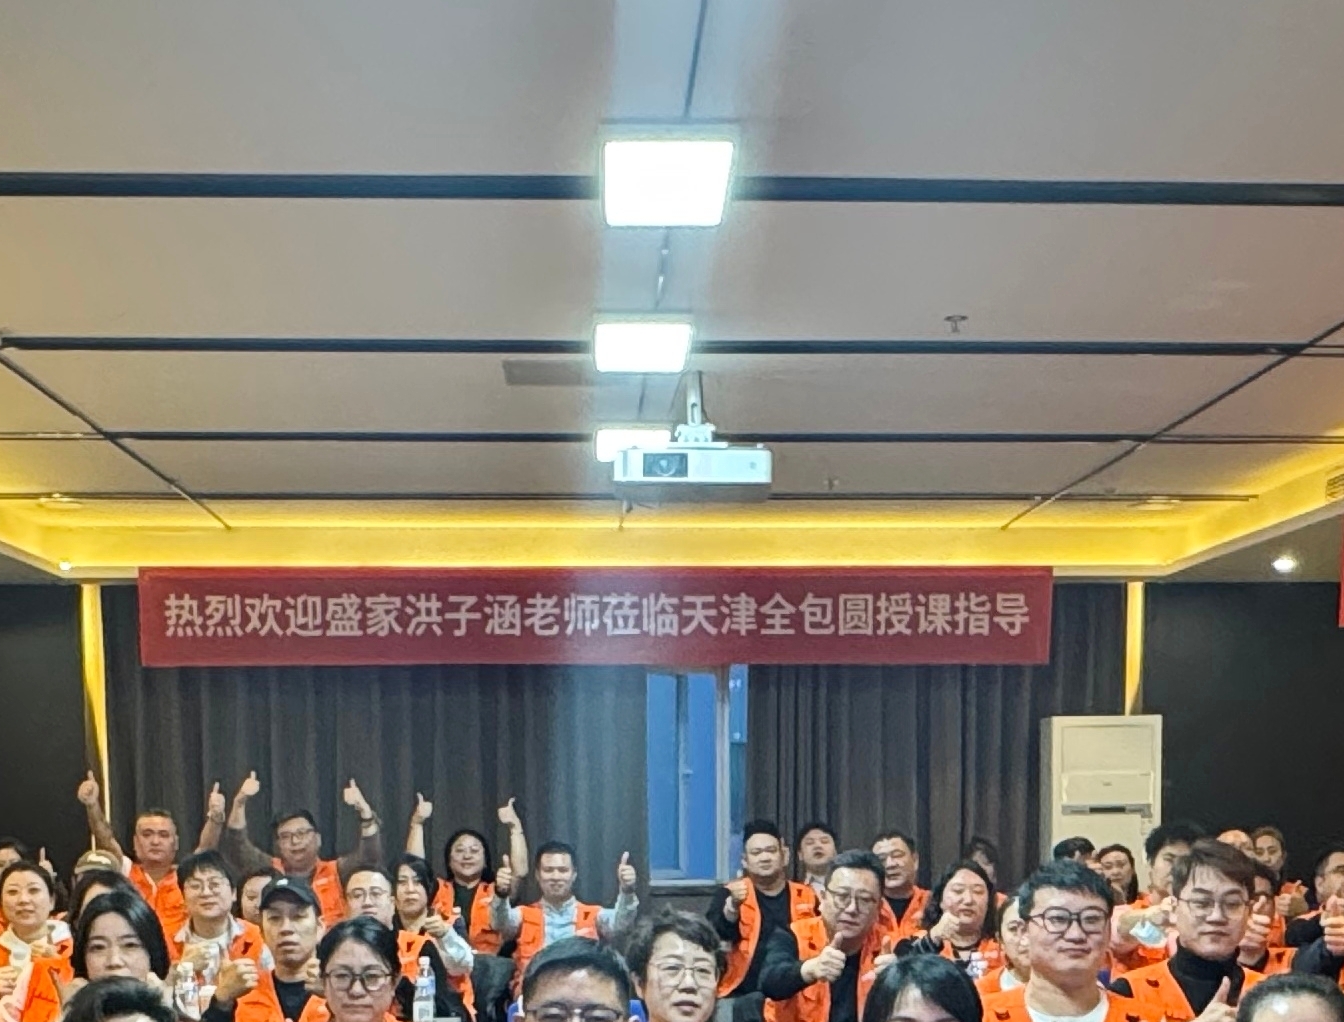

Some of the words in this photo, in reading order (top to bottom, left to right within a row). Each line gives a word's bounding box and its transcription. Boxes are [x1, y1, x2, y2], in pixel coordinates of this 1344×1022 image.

[164, 592, 1030, 638] 热烈欢迎盛家洪子涵老师莅临天津全包圆授课指导
